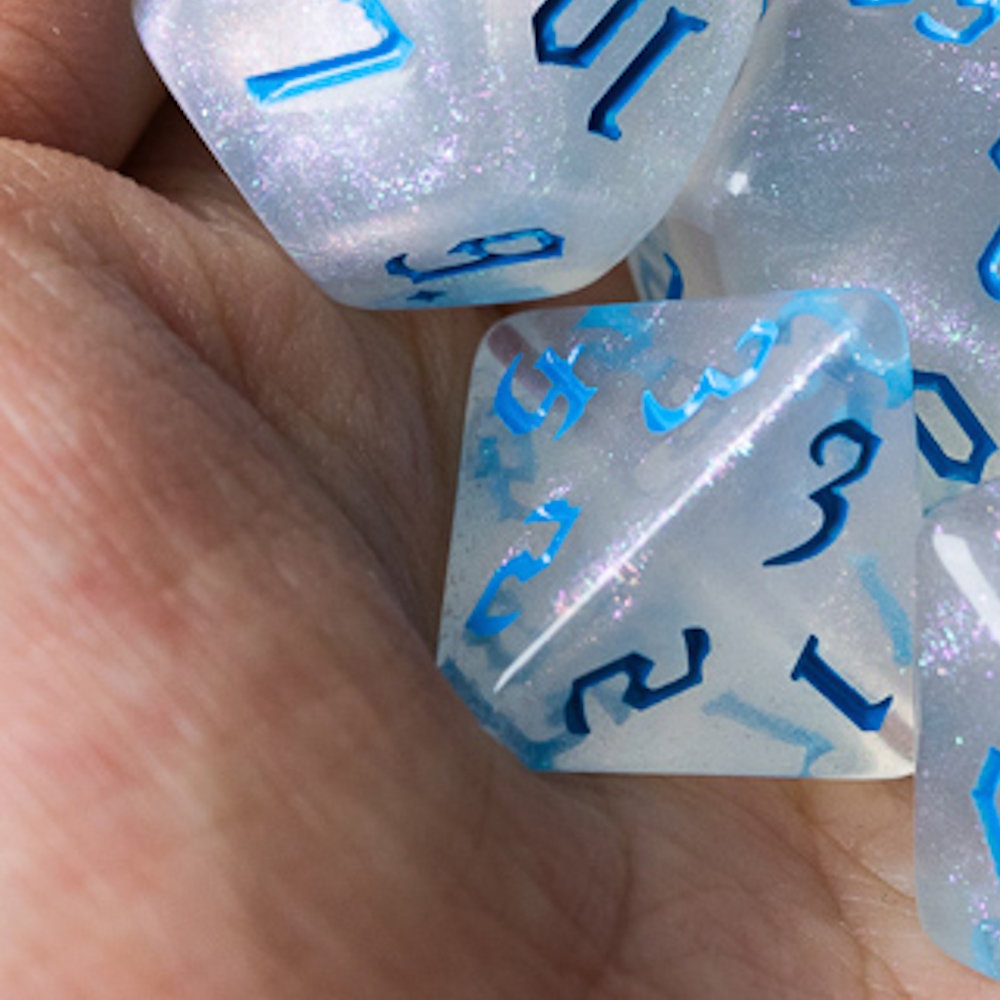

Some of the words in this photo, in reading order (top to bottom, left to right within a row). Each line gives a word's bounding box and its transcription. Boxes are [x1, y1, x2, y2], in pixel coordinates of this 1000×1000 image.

[493, 342, 599, 441] 4
[641, 318, 779, 435] 3
[762, 418, 883, 567] 3
[464, 498, 583, 638] 2
[565, 626, 712, 735] 2
[791, 634, 894, 733] 1
